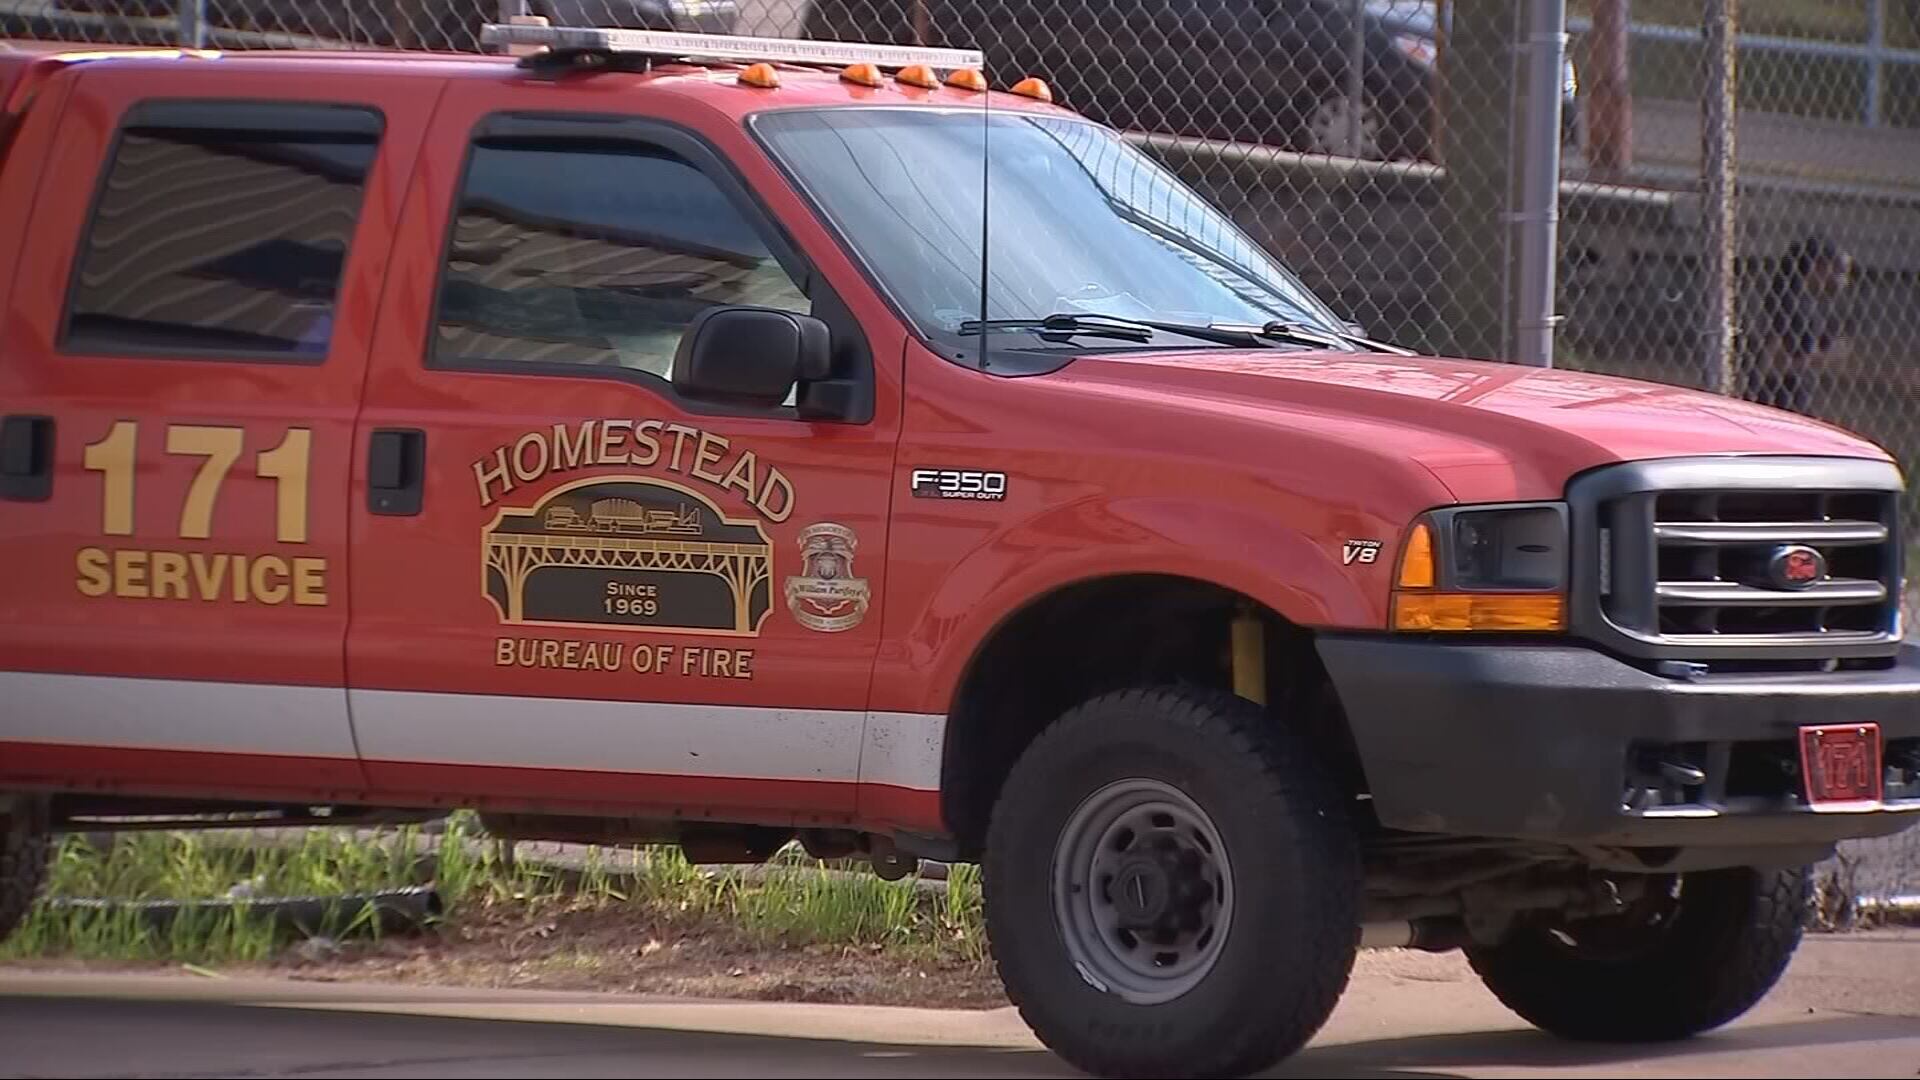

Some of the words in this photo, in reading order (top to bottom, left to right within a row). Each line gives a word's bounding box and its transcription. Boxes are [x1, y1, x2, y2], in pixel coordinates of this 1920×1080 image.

[84, 420, 311, 543] 171
[471, 420, 796, 523] HOMESTEAD
[76, 547, 328, 606] SERVICE
[1344, 545, 1377, 565] V8
[605, 598, 657, 615] 1969
[607, 581, 657, 597] SINCE
[496, 638, 623, 671] BUREAU
[631, 644, 673, 674] OF
[681, 647, 754, 679] FIRE
[1816, 742, 1867, 788] 171
